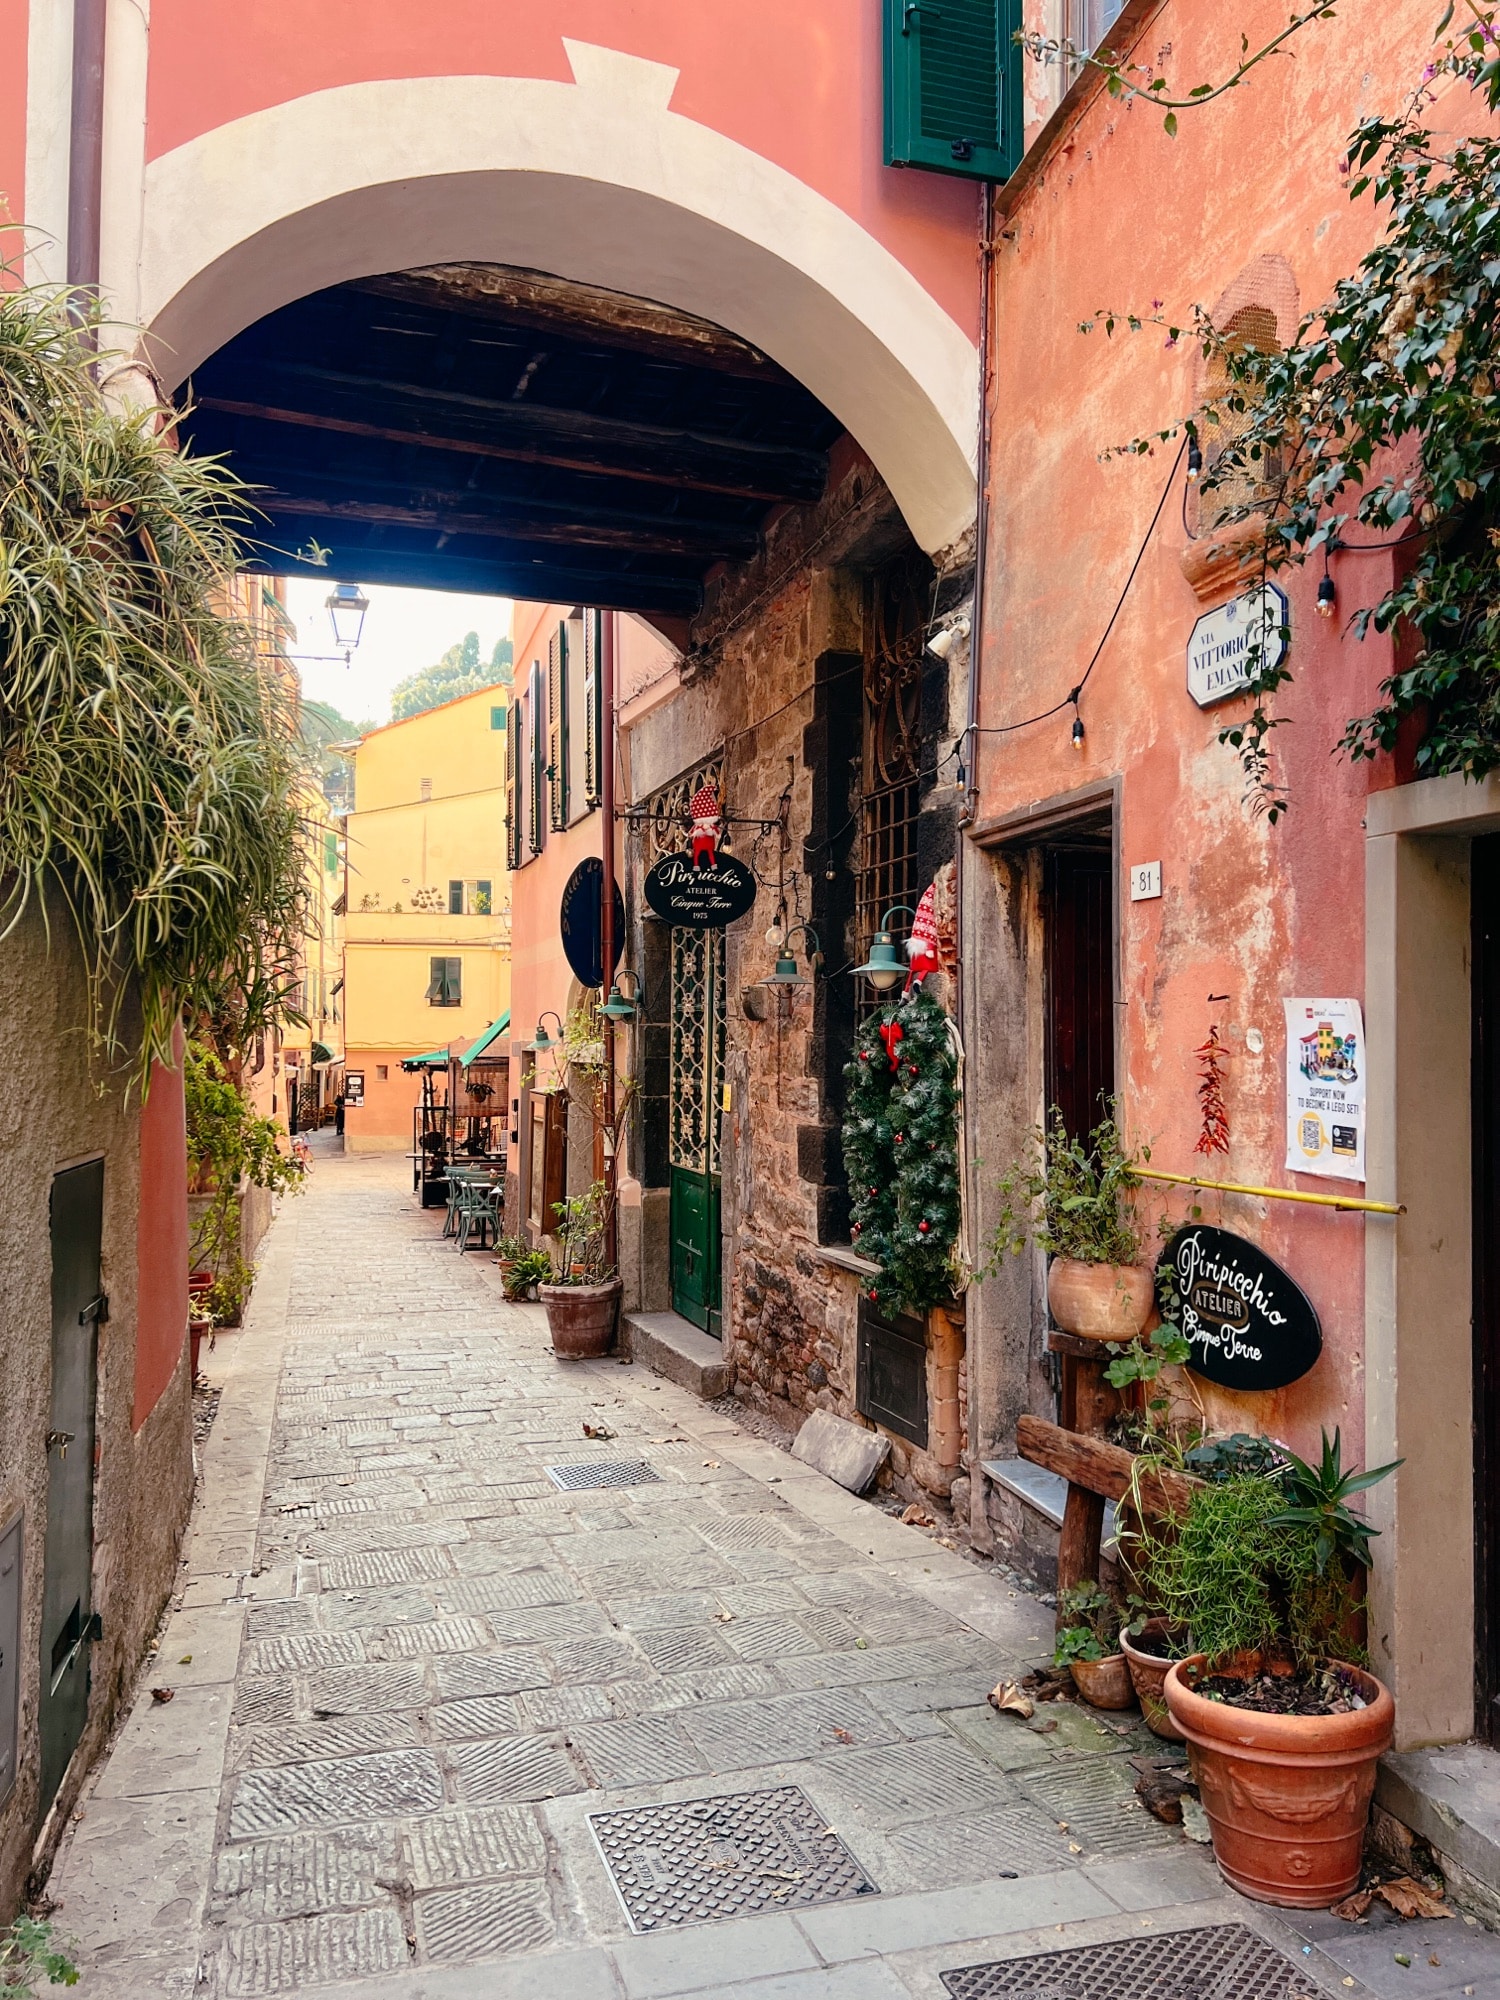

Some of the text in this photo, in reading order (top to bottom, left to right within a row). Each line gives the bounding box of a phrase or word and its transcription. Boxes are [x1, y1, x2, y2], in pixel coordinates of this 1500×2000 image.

[1200, 632, 1215, 646] VIA
[1193, 634, 1249, 671] VITTORIO
[1207, 648, 1271, 690] EMANUE
[685, 887, 717, 895] ATELIER
[1139, 871, 1151, 892] 81
[670, 895, 732, 910] Cinque Terre
[1309, 1087, 1346, 1101] SUPPORT NOW
[1298, 1097, 1304, 1108] TO
[1305, 1098, 1326, 1111] BECOME
[1331, 1101, 1346, 1113] LEGO
[1346, 1103, 1359, 1115] SET!
[1177, 1231, 1287, 1326] Piripicchio
[1195, 1289, 1242, 1318] ATELIER
[1182, 1304, 1263, 1365] Cinque Terre
